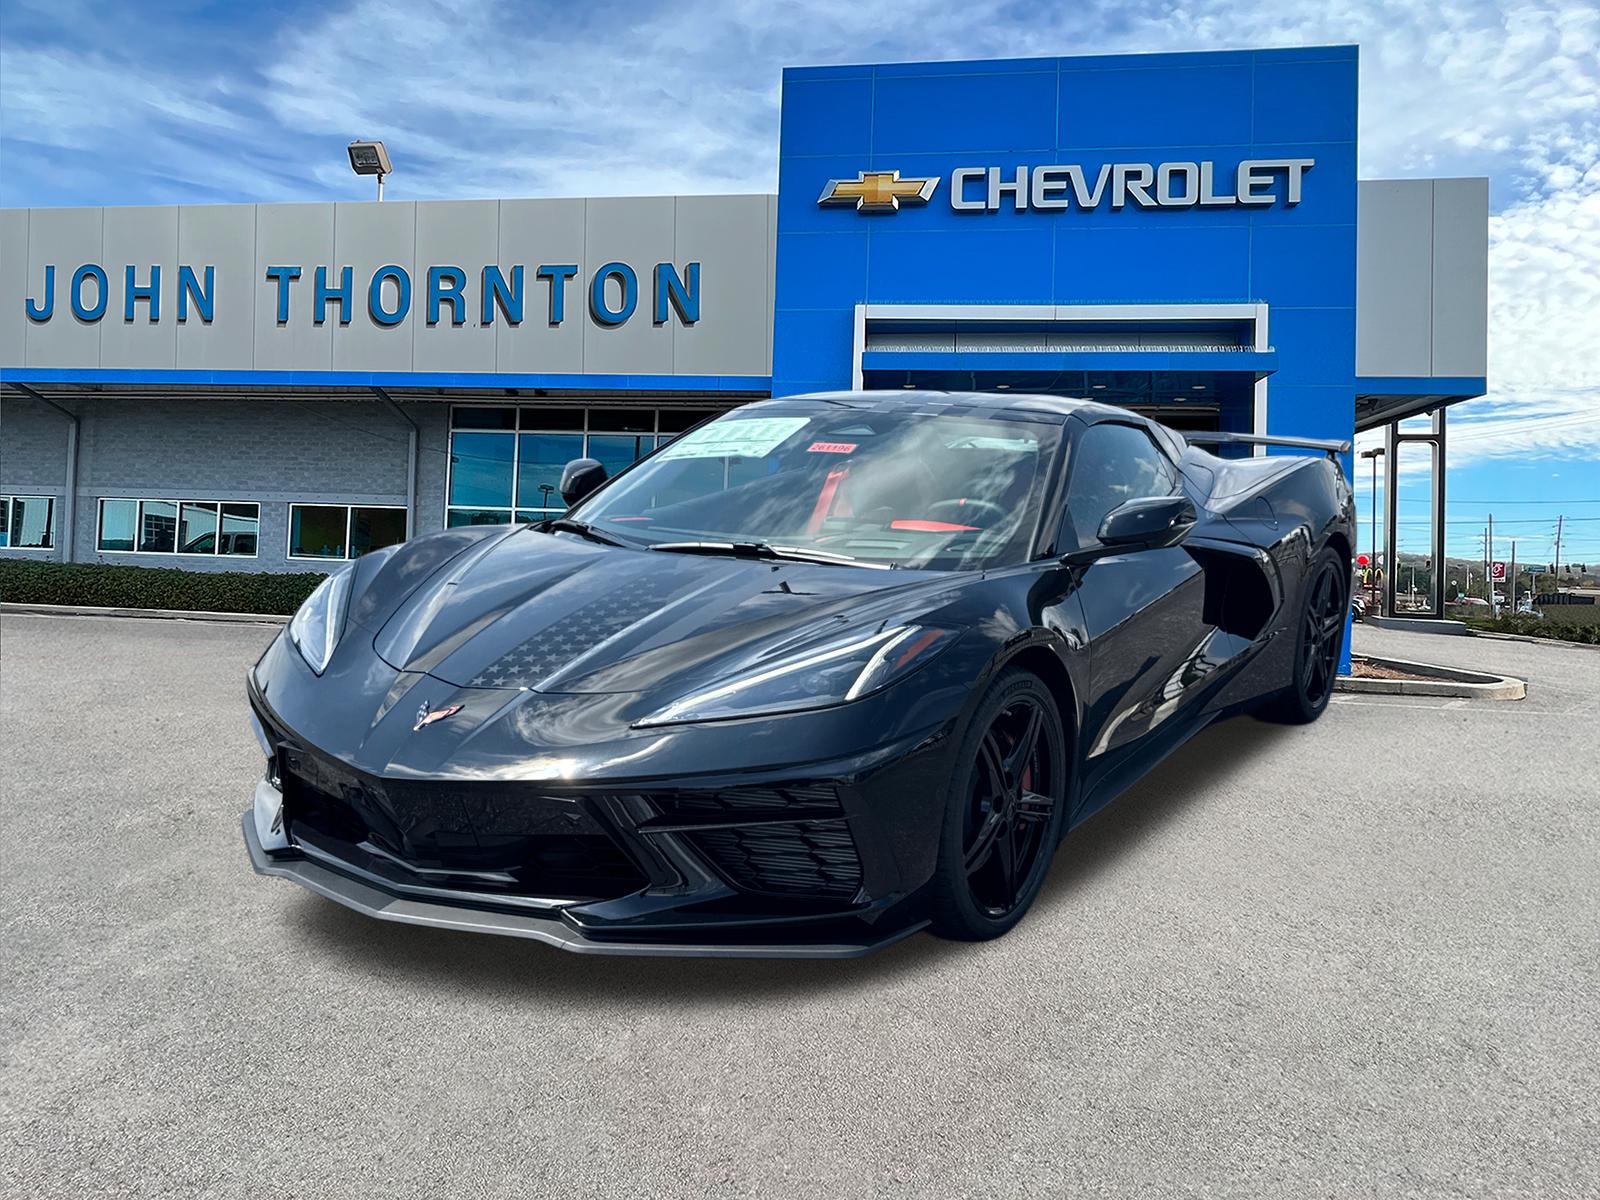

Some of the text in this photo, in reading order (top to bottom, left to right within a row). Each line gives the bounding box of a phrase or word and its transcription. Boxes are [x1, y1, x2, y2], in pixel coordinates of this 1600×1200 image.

[950, 158, 1315, 211] CHEVROLET
[25, 261, 701, 327] JOHN THORNTON
